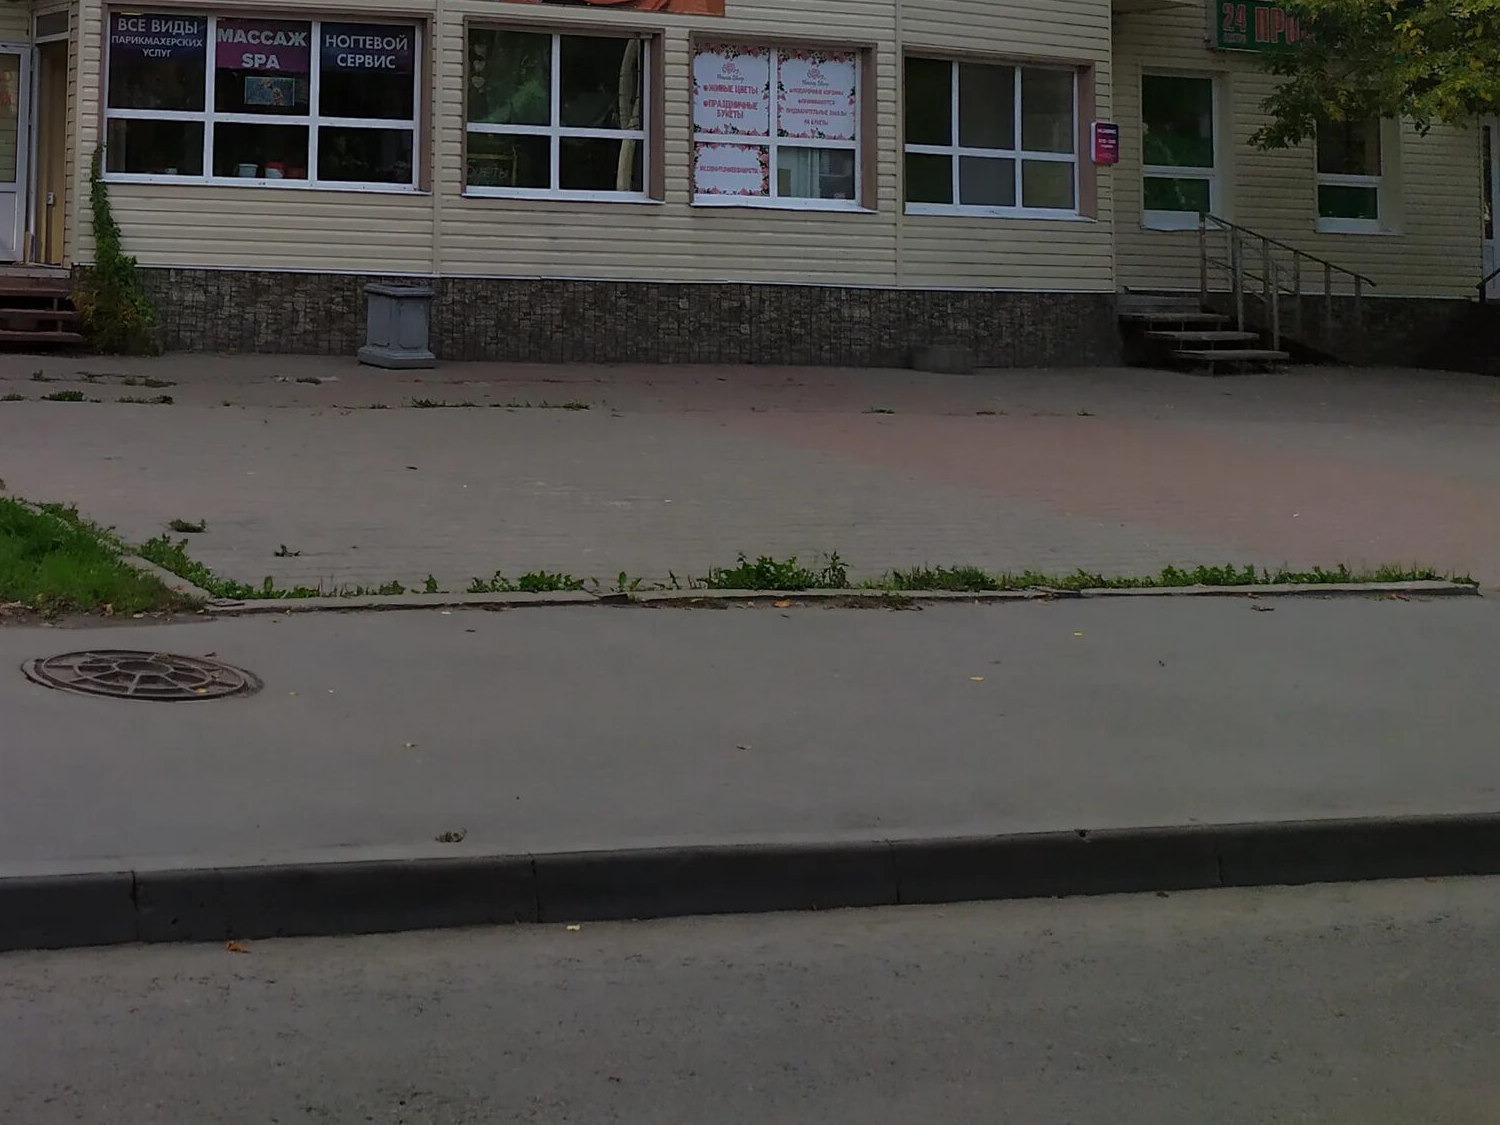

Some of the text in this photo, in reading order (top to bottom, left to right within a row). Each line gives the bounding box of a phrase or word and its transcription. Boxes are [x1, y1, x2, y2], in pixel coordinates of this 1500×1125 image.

[1222, 3, 1246, 32] 24
[118, 18, 198, 36] ВСЕ ВИДЫ
[111, 35, 203, 48] ПАРИКМАХЕРСКИХ
[217, 28, 308, 48] МАССАЖ
[325, 32, 408, 52] НОГТЕВОЙ
[142, 48, 172, 58] УСЛУГ
[242, 53, 281, 69] SPA
[336, 53, 396, 69] СЕРВИС
[735, 85, 758, 95] ЦВЕТЫ
[716, 109, 744, 119] БУКЕТЫ
